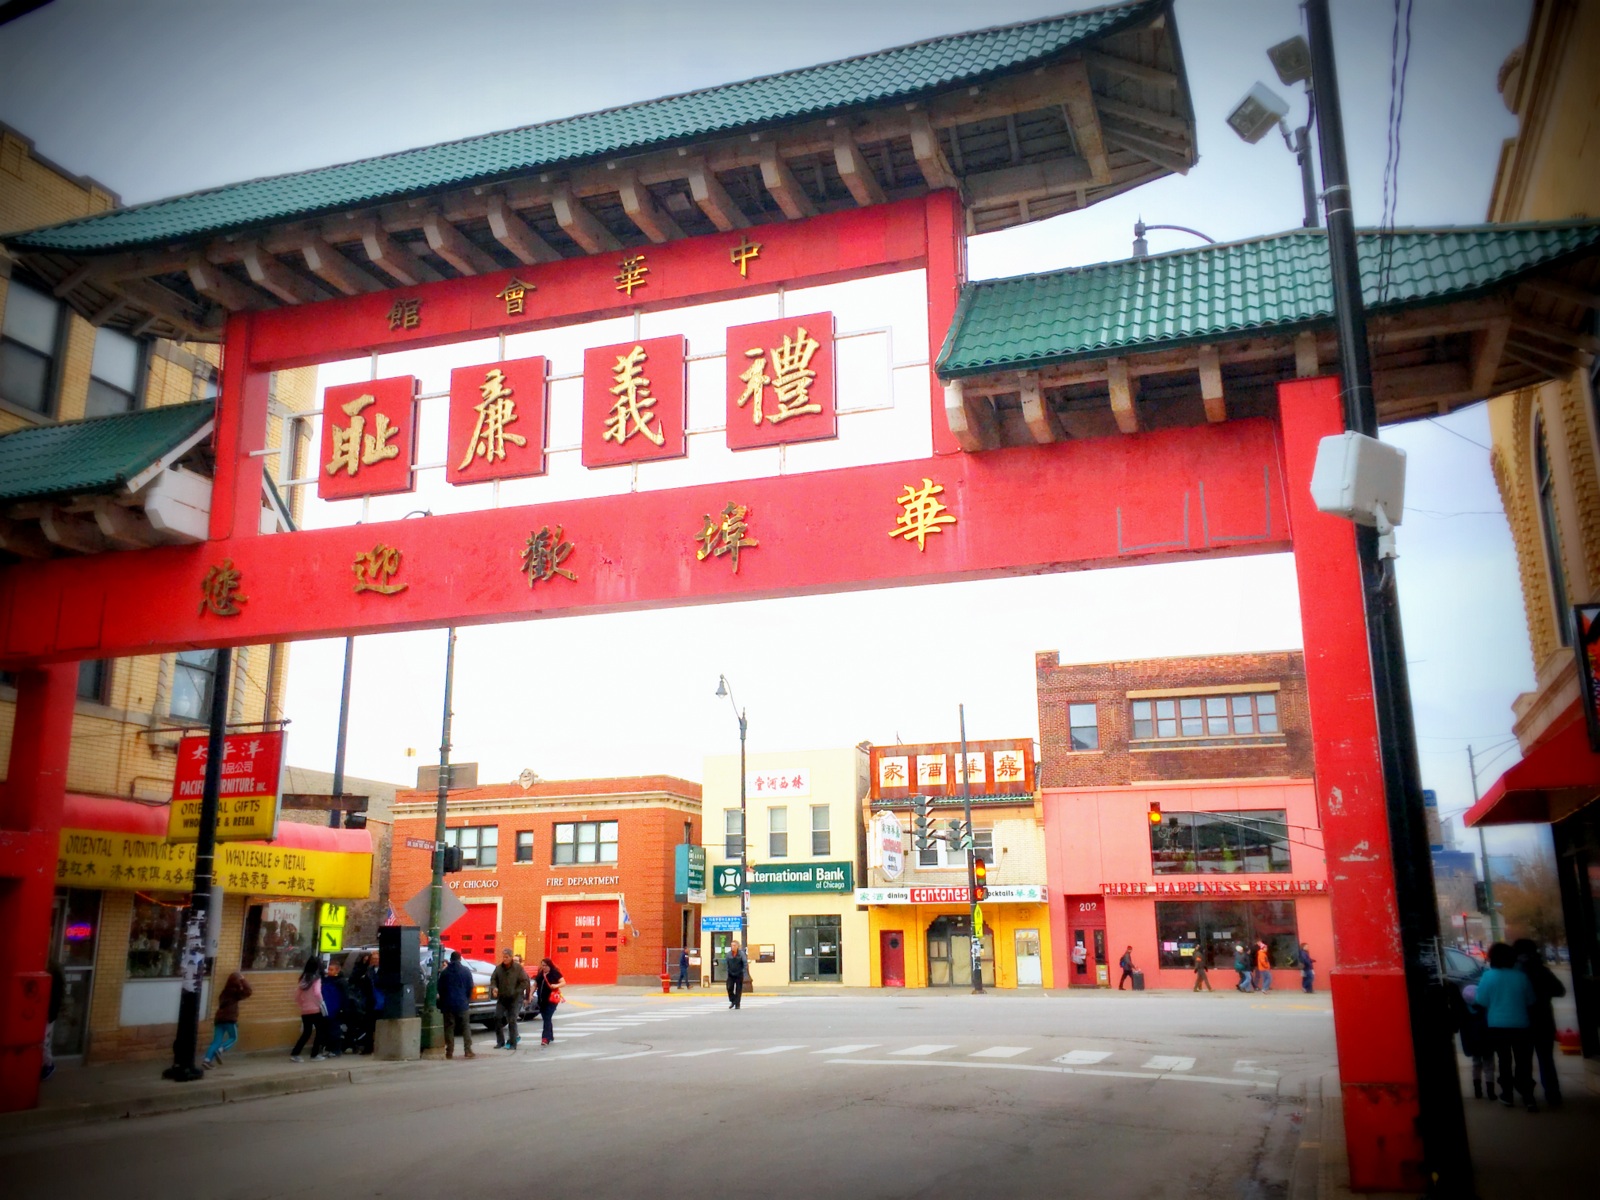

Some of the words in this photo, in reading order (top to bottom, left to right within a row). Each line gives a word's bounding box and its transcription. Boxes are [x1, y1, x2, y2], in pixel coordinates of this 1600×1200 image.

[180, 779, 205, 795] PACIFI
[220, 777, 255, 793] RNITURE
[181, 801, 228, 815] ORIEAL
[234, 800, 260, 813] GIFTS
[233, 816, 255, 827] RETAIL
[65, 834, 112, 857] ORIENTAL
[123, 839, 173, 861] FURNITURE
[226, 849, 272, 868] WHOLESALE
[274, 855, 280, 867] &
[283, 854, 306, 871] RETAIL
[746, 868, 812, 882] nternational
[816, 867, 844, 881] Bank
[449, 881, 460, 889] OF
[463, 880, 499, 889] CHICAGO
[546, 877, 564, 887] FIRE
[567, 875, 620, 886] DEPARTMENT
[823, 880, 845, 889] Chicago
[914, 888, 970, 901] cantones
[1099, 882, 1149, 897] THREE
[1155, 881, 1241, 895] HAPPINESS
[1079, 903, 1096, 912] 202
[575, 916, 595, 927] ENGINE
[65, 927, 92, 938] OPEN
[575, 957, 590, 969] AMB.
